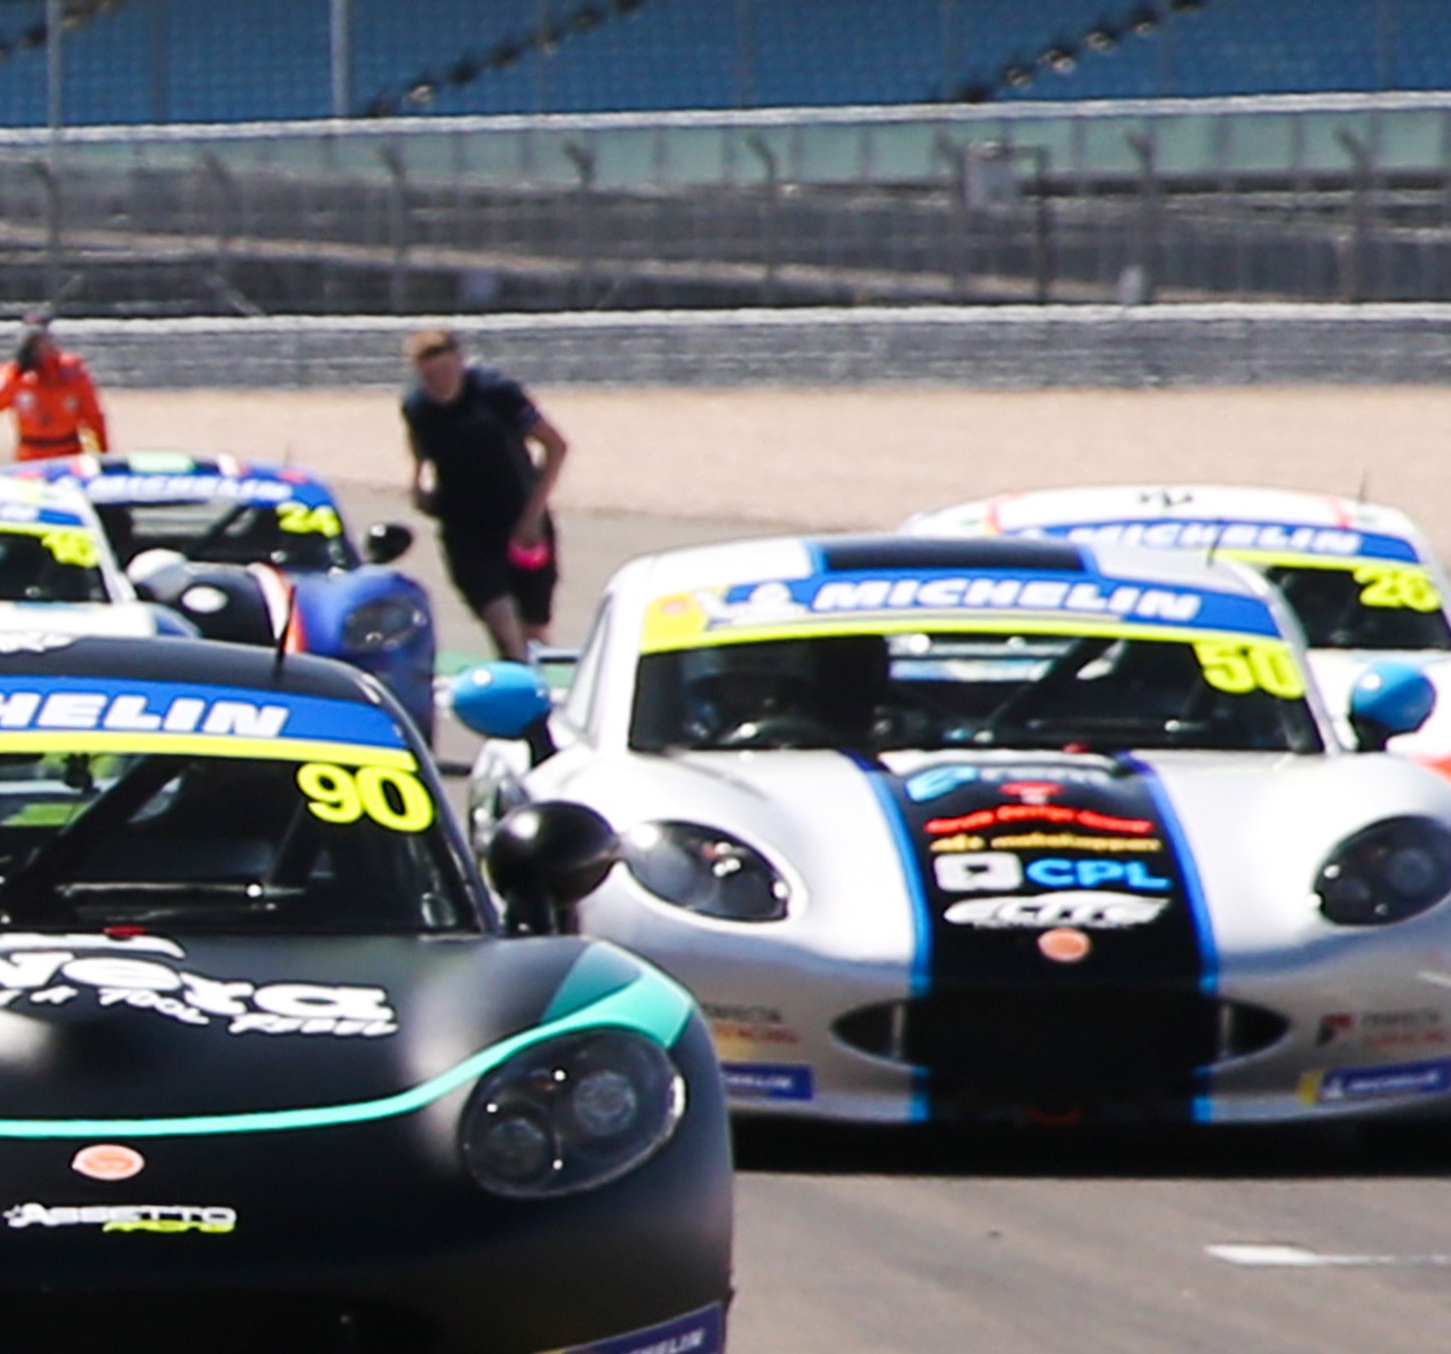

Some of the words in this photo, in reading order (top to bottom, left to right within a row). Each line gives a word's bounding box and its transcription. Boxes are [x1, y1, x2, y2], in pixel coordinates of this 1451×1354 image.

[812, 577, 1203, 623] MICHELIN
[1193, 642, 1307, 699] 50
[296, 761, 435, 833] 90
[1025, 857, 1173, 890] CPL
